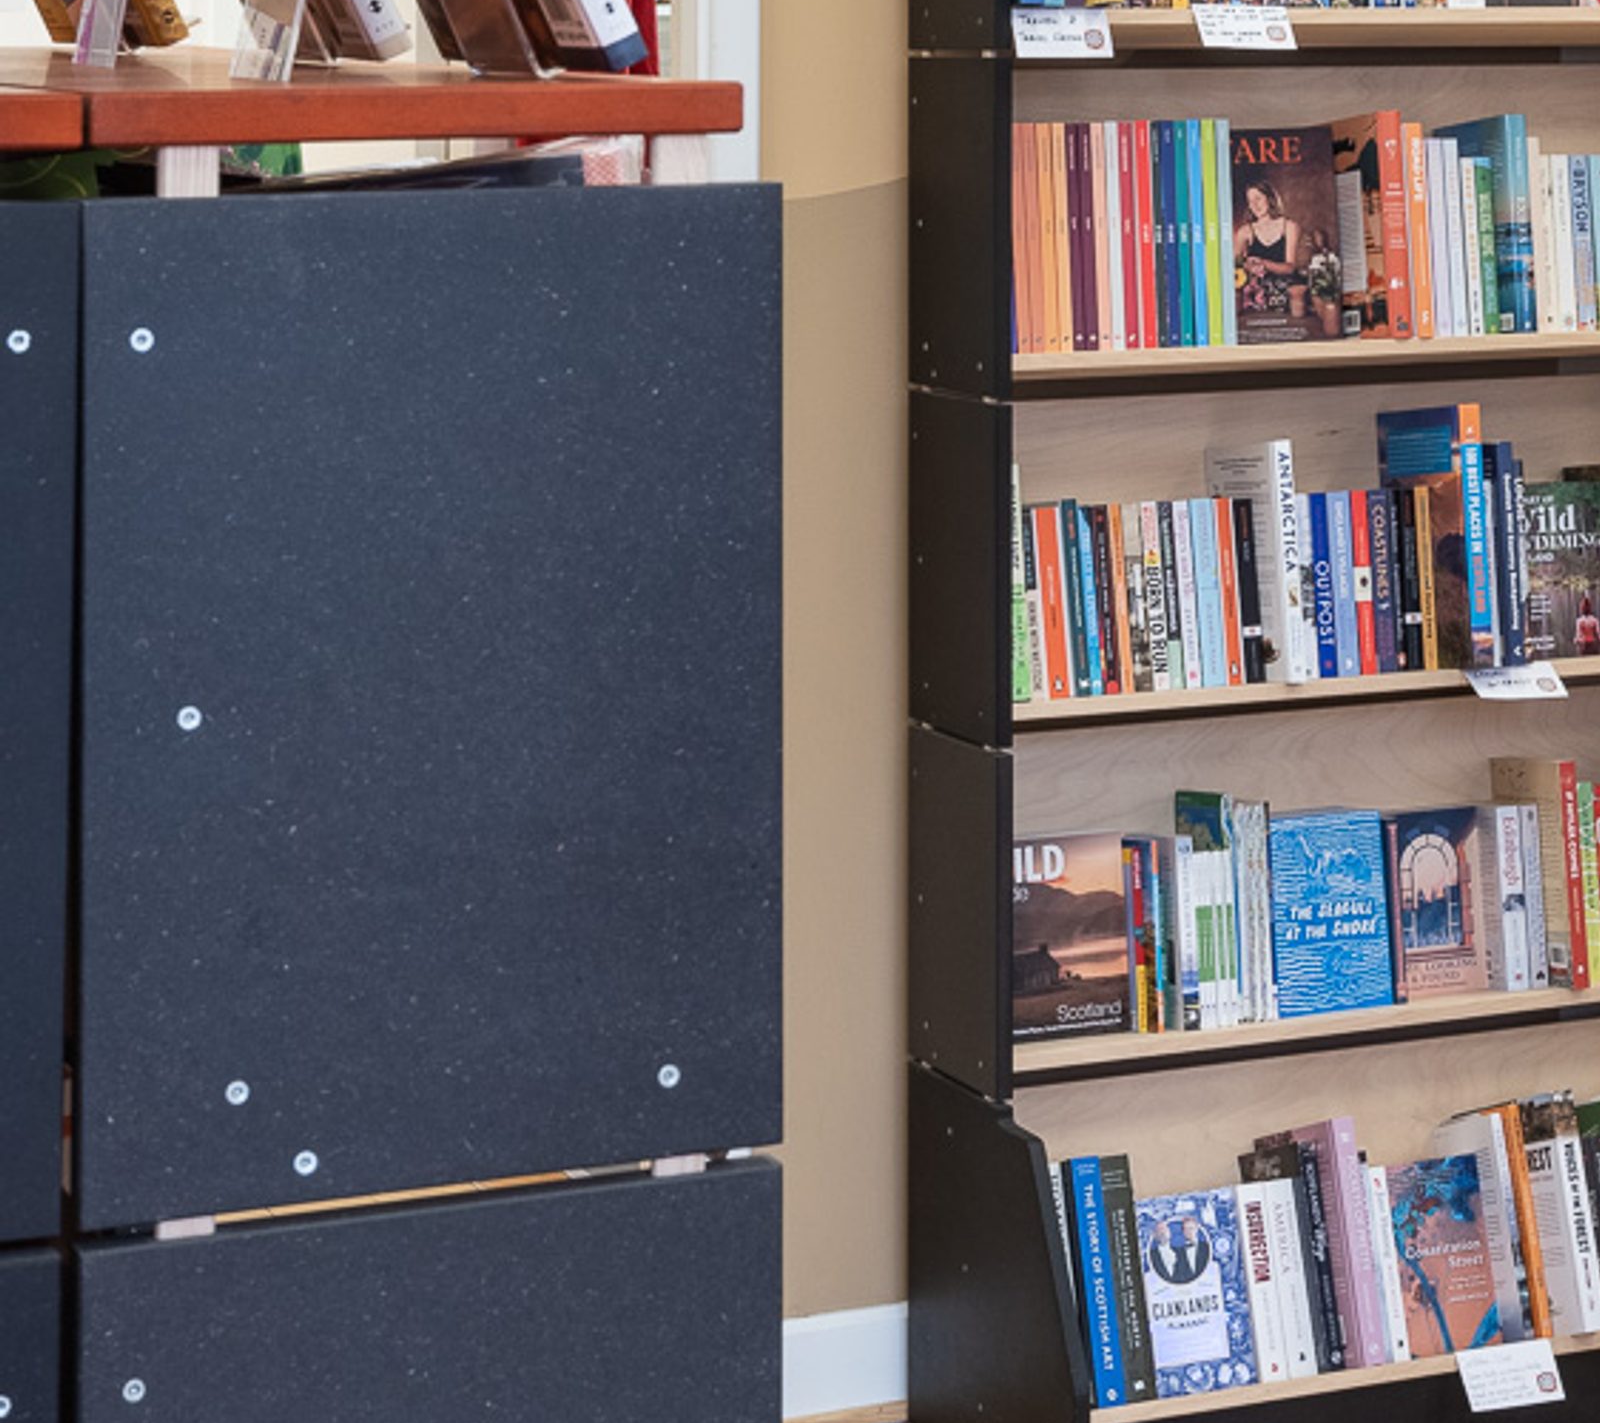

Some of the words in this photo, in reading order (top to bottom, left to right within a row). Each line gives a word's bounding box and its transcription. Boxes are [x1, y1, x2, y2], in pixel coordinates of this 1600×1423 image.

[1230, 136, 1301, 164] ARE
[1573, 168, 1588, 232] BRYSON
[1467, 467, 1478, 494] BEST
[1277, 451, 1298, 573] ANTARCTICA
[1468, 496, 1481, 539] PLACES
[1372, 504, 1389, 598] COASTLINES
[1472, 542, 1483, 553] IN
[1146, 566, 1162, 609] BORN
[1472, 556, 1485, 613] SCOTLAND
[1316, 560, 1334, 646] OUTPOST
[1151, 616, 1164, 635] TO
[1152, 641, 1167, 673] RUN
[1501, 817, 1520, 887] Edinburgh
[1290, 905, 1314, 920] THE
[1331, 917, 1377, 936] SHORE
[1056, 1000, 1122, 1022] Scotland
[1084, 1184, 1094, 1209] THE
[1564, 1143, 1579, 1182] VOICES
[1572, 1212, 1589, 1254] FOREST
[1086, 1212, 1098, 1253] STORY
[1245, 1201, 1271, 1283] INSURRECTION
[1092, 1258, 1102, 1273] OF
[1093, 1277, 1109, 1342] SCOTTISH
[1152, 1295, 1219, 1321] CLANLANDS
[1102, 1346, 1114, 1371] ART
